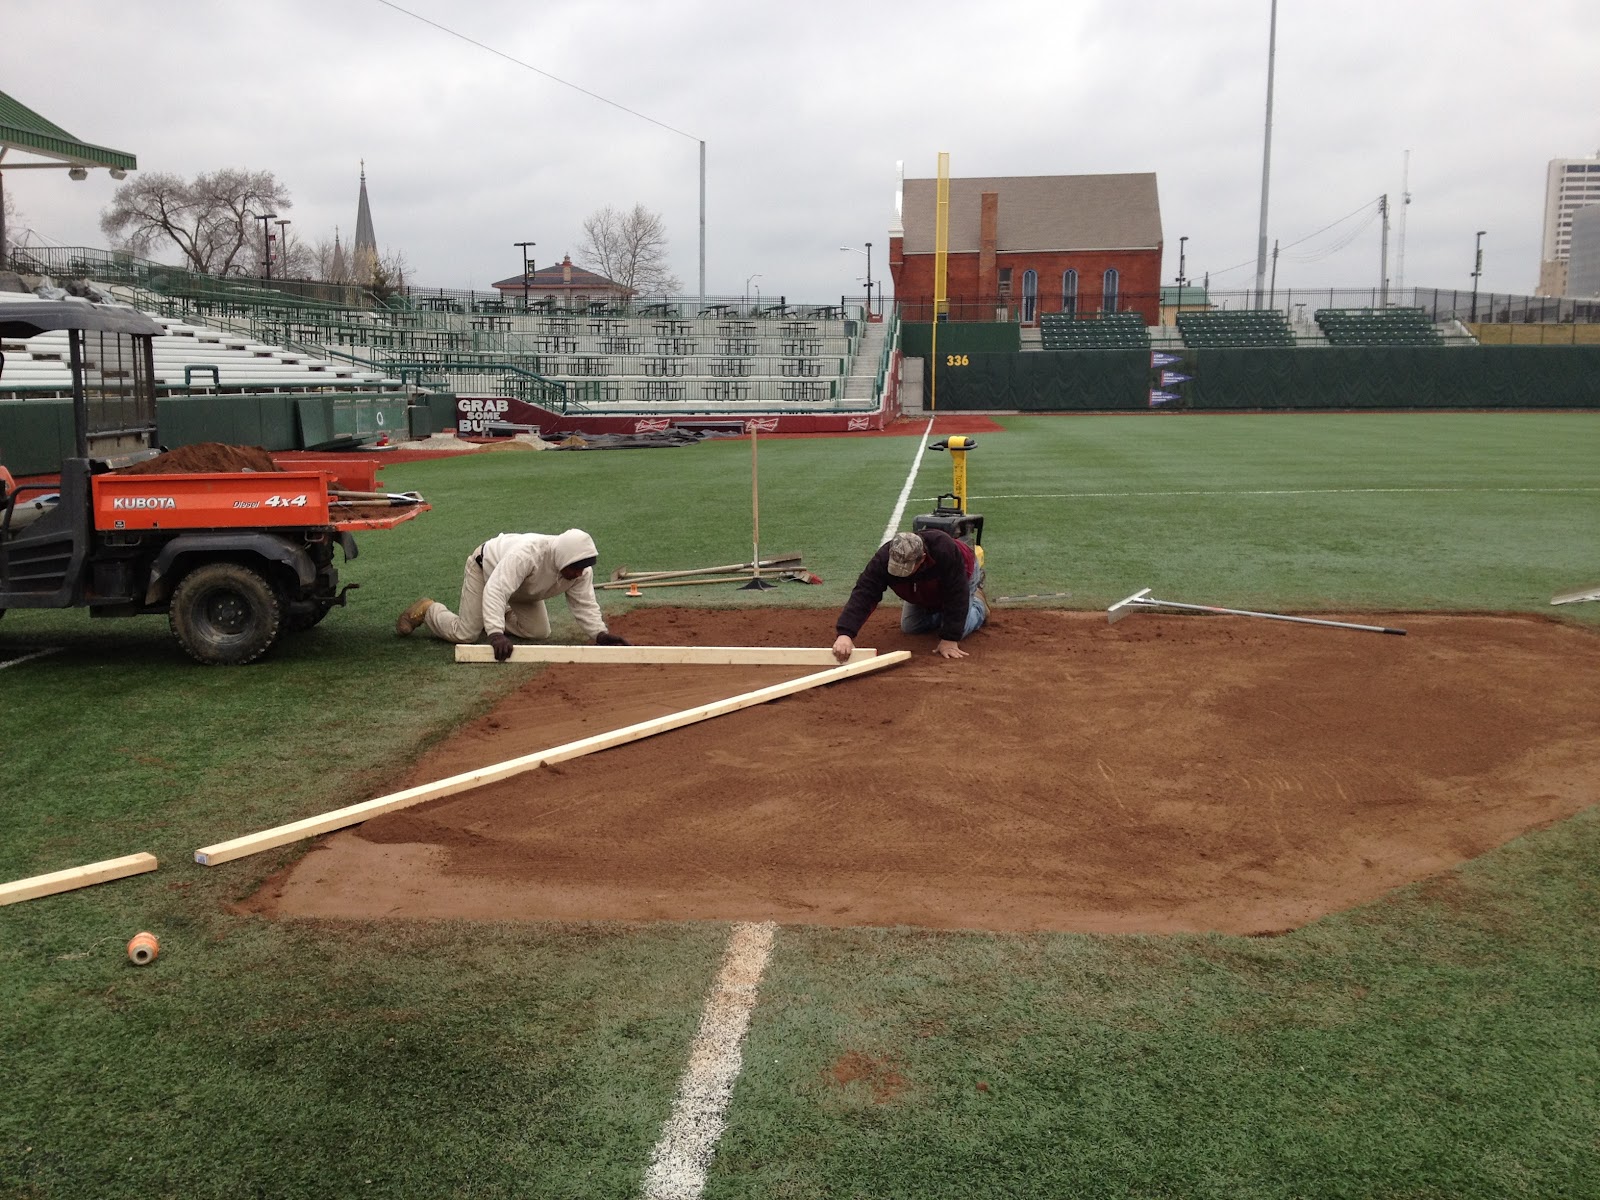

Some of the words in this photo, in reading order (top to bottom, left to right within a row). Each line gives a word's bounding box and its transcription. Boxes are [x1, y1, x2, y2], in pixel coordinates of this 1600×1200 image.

[946, 354, 969, 366] 336
[458, 399, 509, 412] GRAB
[467, 411, 501, 420] SOME
[113, 497, 176, 509] KUBOTA
[264, 495, 307, 507] 4x4
